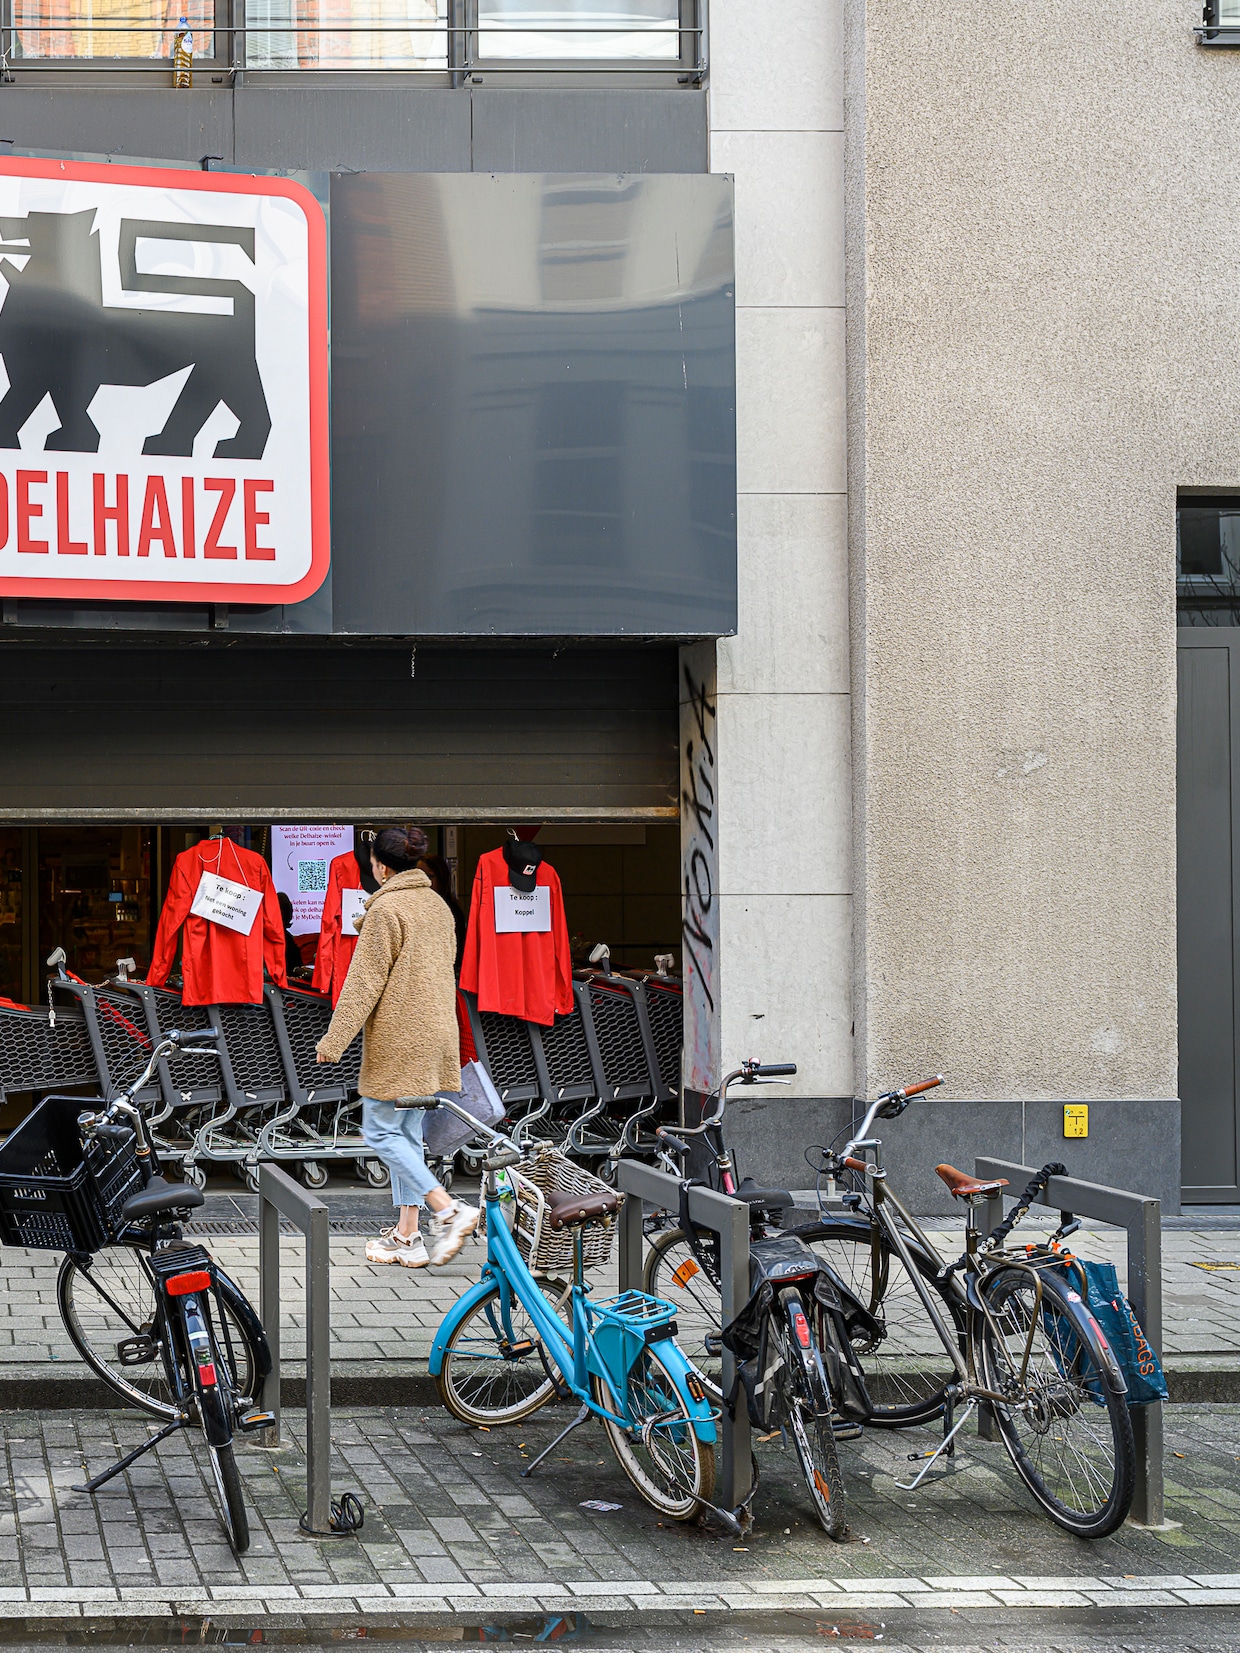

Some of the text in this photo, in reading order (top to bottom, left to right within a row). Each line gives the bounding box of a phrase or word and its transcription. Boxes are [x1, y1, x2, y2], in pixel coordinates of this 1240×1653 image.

[216, 884, 224, 892] Te
[224, 887, 242, 899] koop
[212, 908, 234, 920] gekocht
[227, 904, 247, 917] woning
